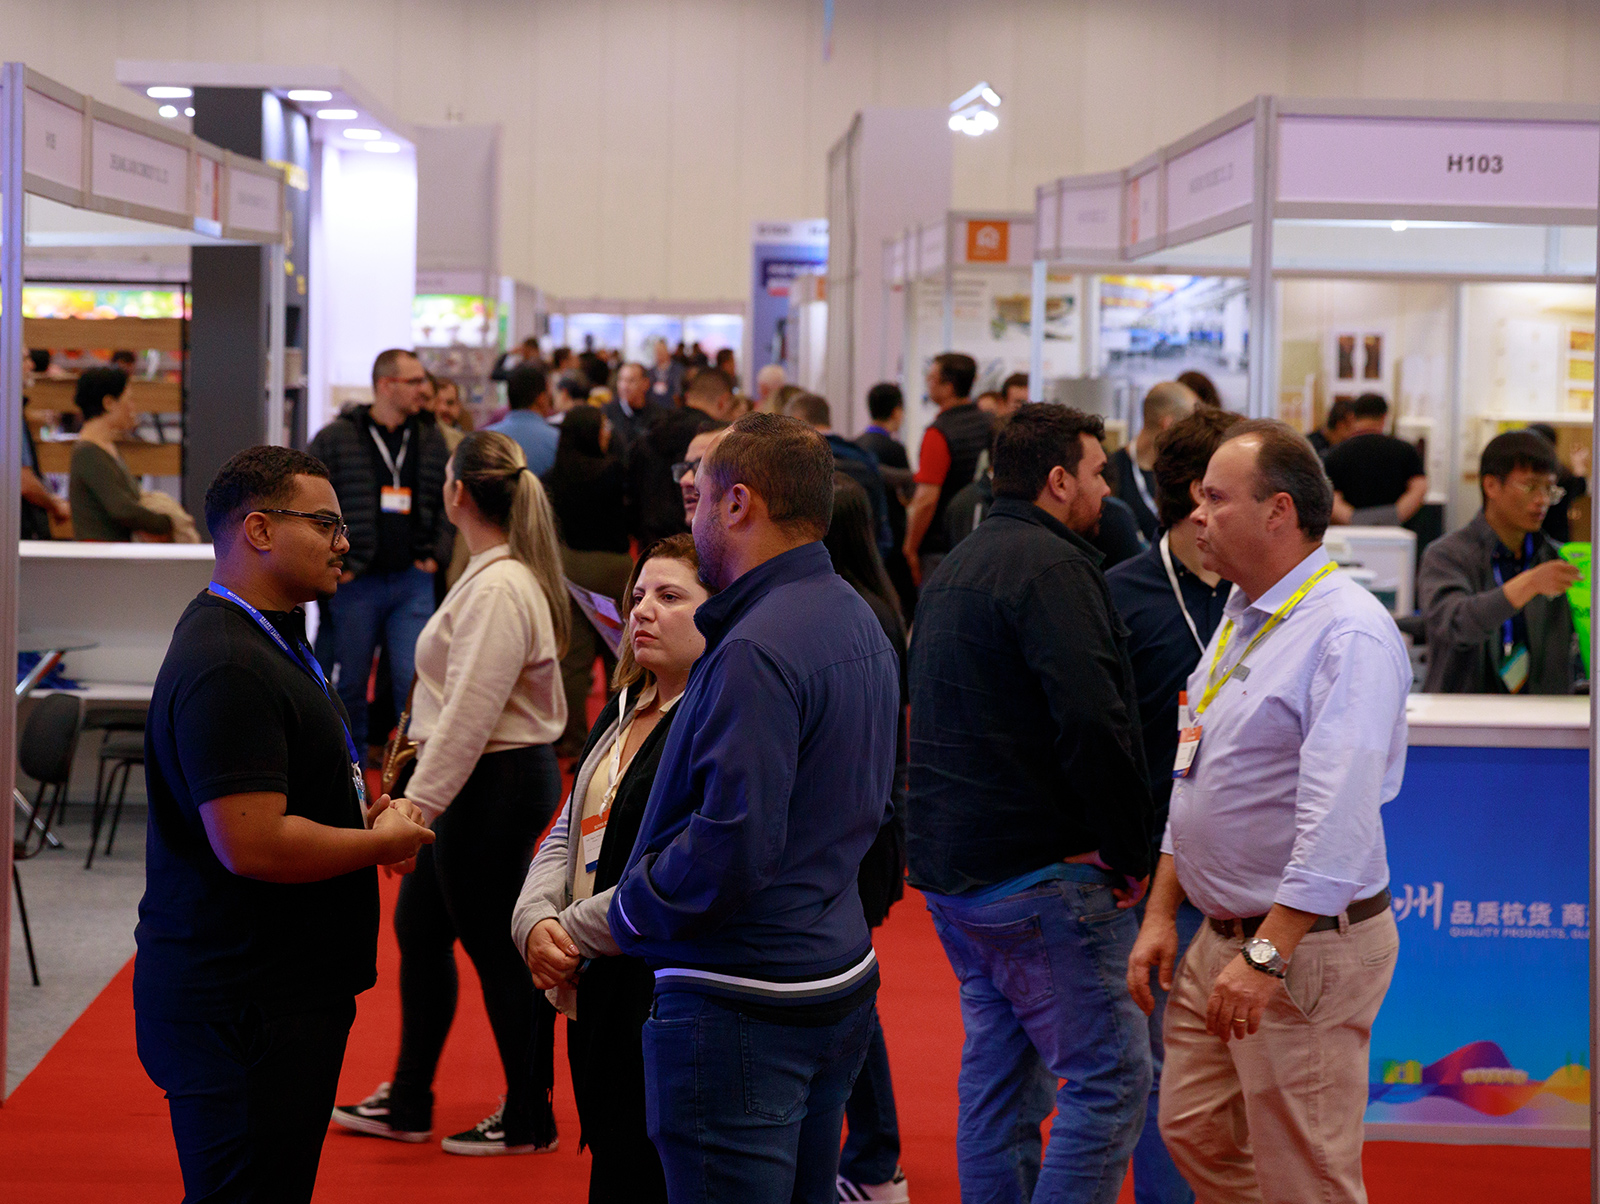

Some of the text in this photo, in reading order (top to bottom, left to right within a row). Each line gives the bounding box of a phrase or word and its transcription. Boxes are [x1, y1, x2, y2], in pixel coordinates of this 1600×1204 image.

[1447, 154, 1504, 174] H103
[1393, 881, 1444, 931] 州
[1561, 902, 1589, 927] 商
[1449, 926, 1499, 938] QUALITY
